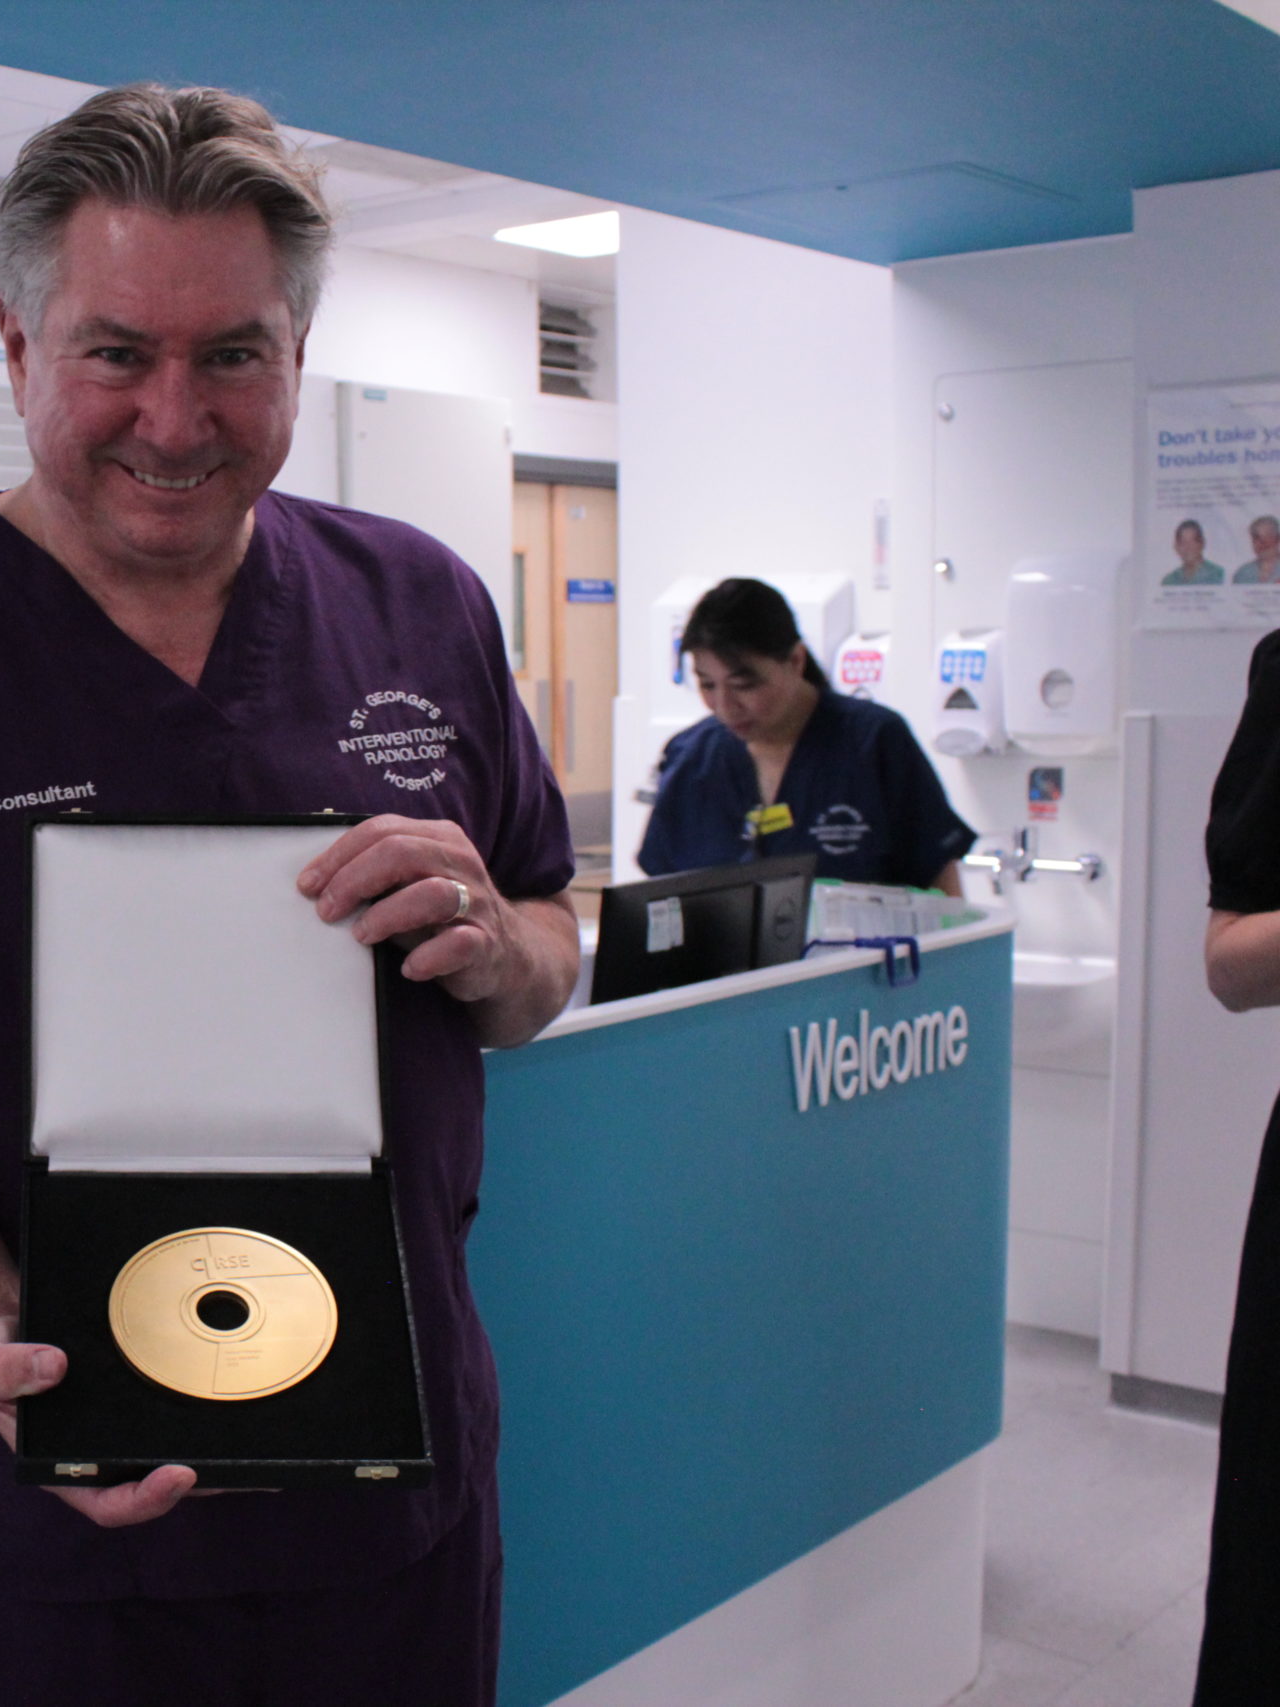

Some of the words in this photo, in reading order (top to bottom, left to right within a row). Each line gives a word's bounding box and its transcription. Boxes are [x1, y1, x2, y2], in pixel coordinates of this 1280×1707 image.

[1158, 430, 1208, 446] Don't
[1215, 426, 1256, 443] take
[1157, 450, 1237, 468] troubles
[365, 691, 442, 720] GEORGE'S
[337, 725, 459, 753] INTERVENTIONAL
[363, 744, 447, 765] RADIOLOGY
[383, 768, 446, 791] HOSPITAL
[789, 1005, 968, 1113] Welcome
